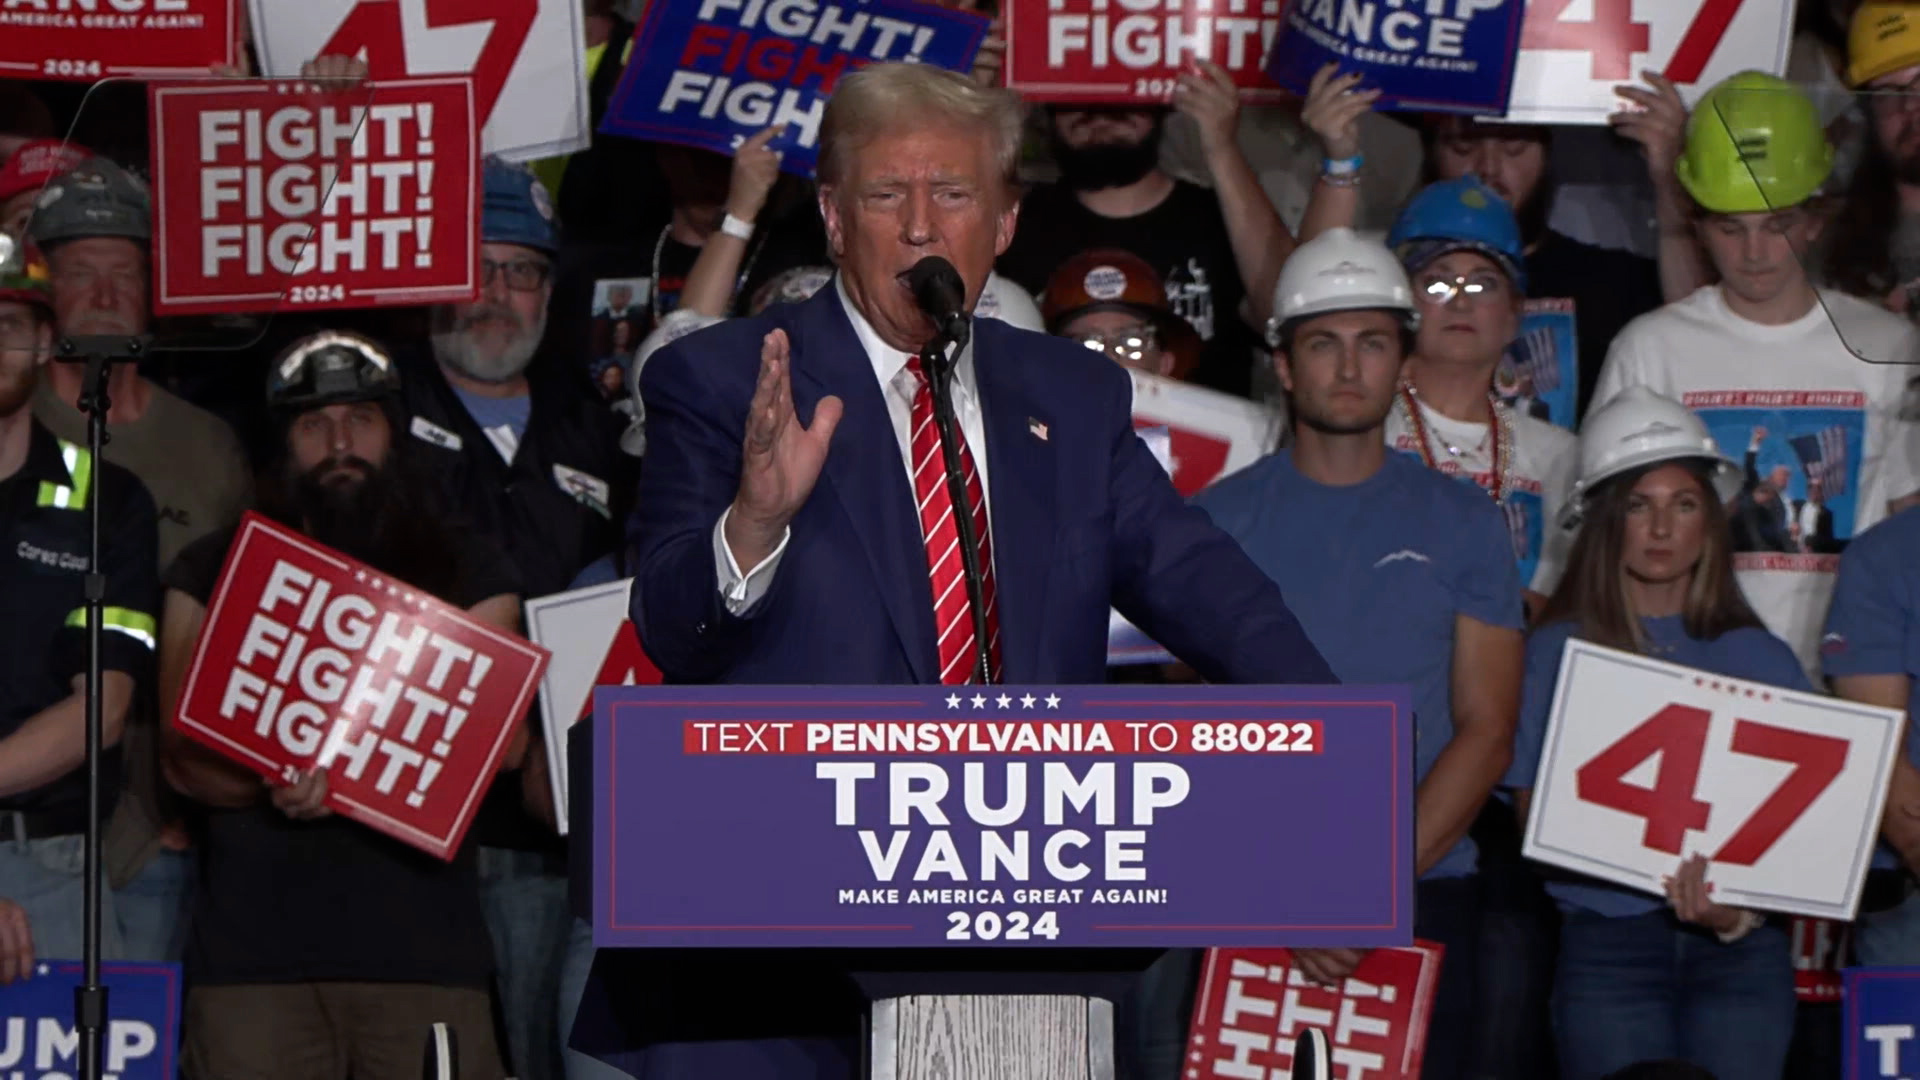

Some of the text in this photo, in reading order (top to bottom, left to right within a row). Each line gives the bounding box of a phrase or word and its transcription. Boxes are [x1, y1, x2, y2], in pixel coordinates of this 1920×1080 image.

[81, 14, 138, 28] GREAT
[1048, 14, 1279, 71] FIGHT!
[1300, 0, 1467, 57] ANCE
[43, 59, 100, 76] 2024
[679, 23, 882, 96] FIGH
[200, 103, 434, 162] FIGHT!
[201, 160, 435, 220] FIGHT!
[202, 216, 433, 277] FIGHT!
[290, 284, 345, 302] 2024
[259, 558, 493, 706] FIGHT!
[237, 612, 469, 757] FIGHT!
[219, 666, 443, 808] FIGHT!
[694, 723, 1313, 752] TEXT PENNSYLVANIA TO 88022
[816, 762, 1190, 827] TRUMP
[1574, 702, 1851, 866] 47
[858, 829, 1147, 882] VANCE
[838, 889, 1168, 904] MAKE AMERICA GREAT AGAIN!
[946, 911, 1060, 941] 2024
